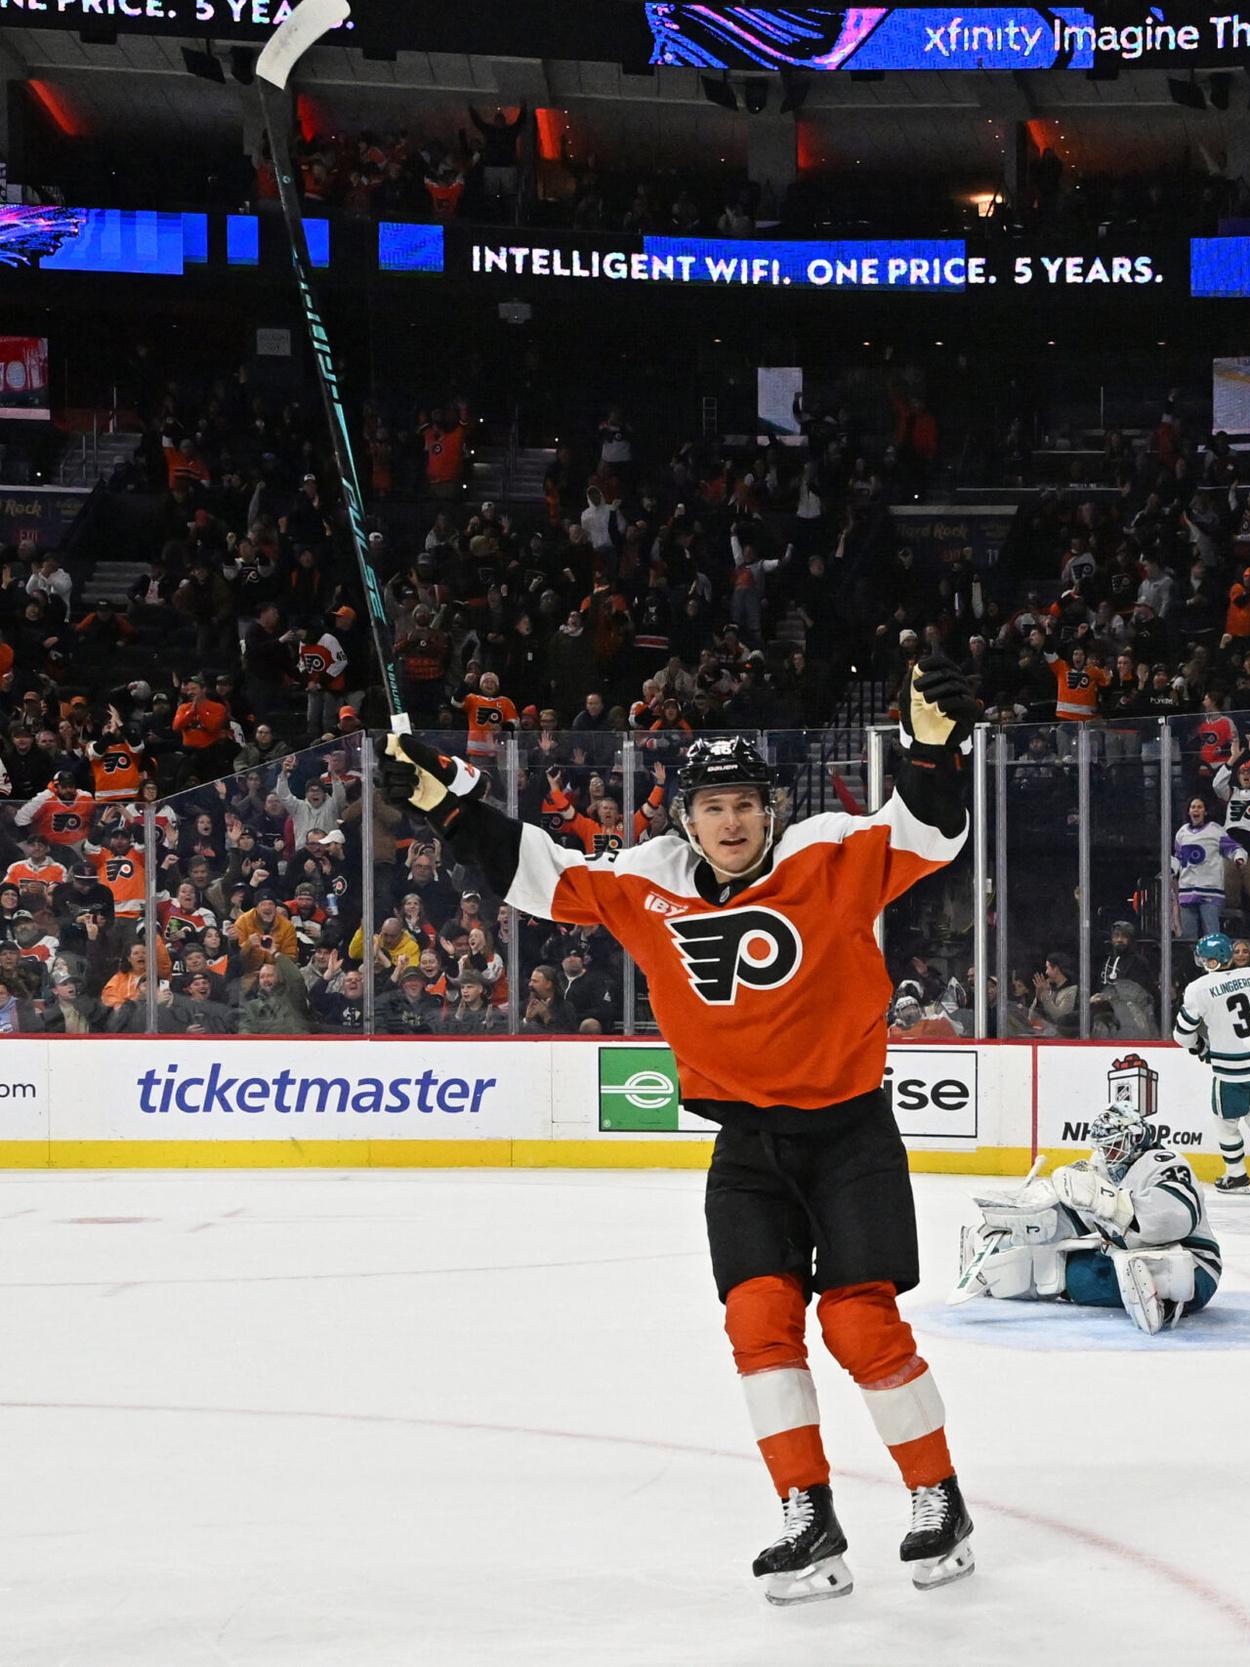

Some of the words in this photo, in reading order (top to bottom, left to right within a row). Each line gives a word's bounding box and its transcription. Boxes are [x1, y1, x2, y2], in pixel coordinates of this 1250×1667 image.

[196, 0, 215, 21] 5
[924, 17, 1042, 57] xfinity
[1054, 17, 1200, 60] Imagine
[472, 245, 696, 282] INTELLIGENT
[705, 256, 791, 286] WIFI.
[807, 257, 879, 285] ONE
[888, 256, 997, 285] PRICE.
[1014, 257, 1033, 284] 5
[1040, 256, 1164, 284] YEARS.
[136, 1062, 497, 1114] ticketmaster
